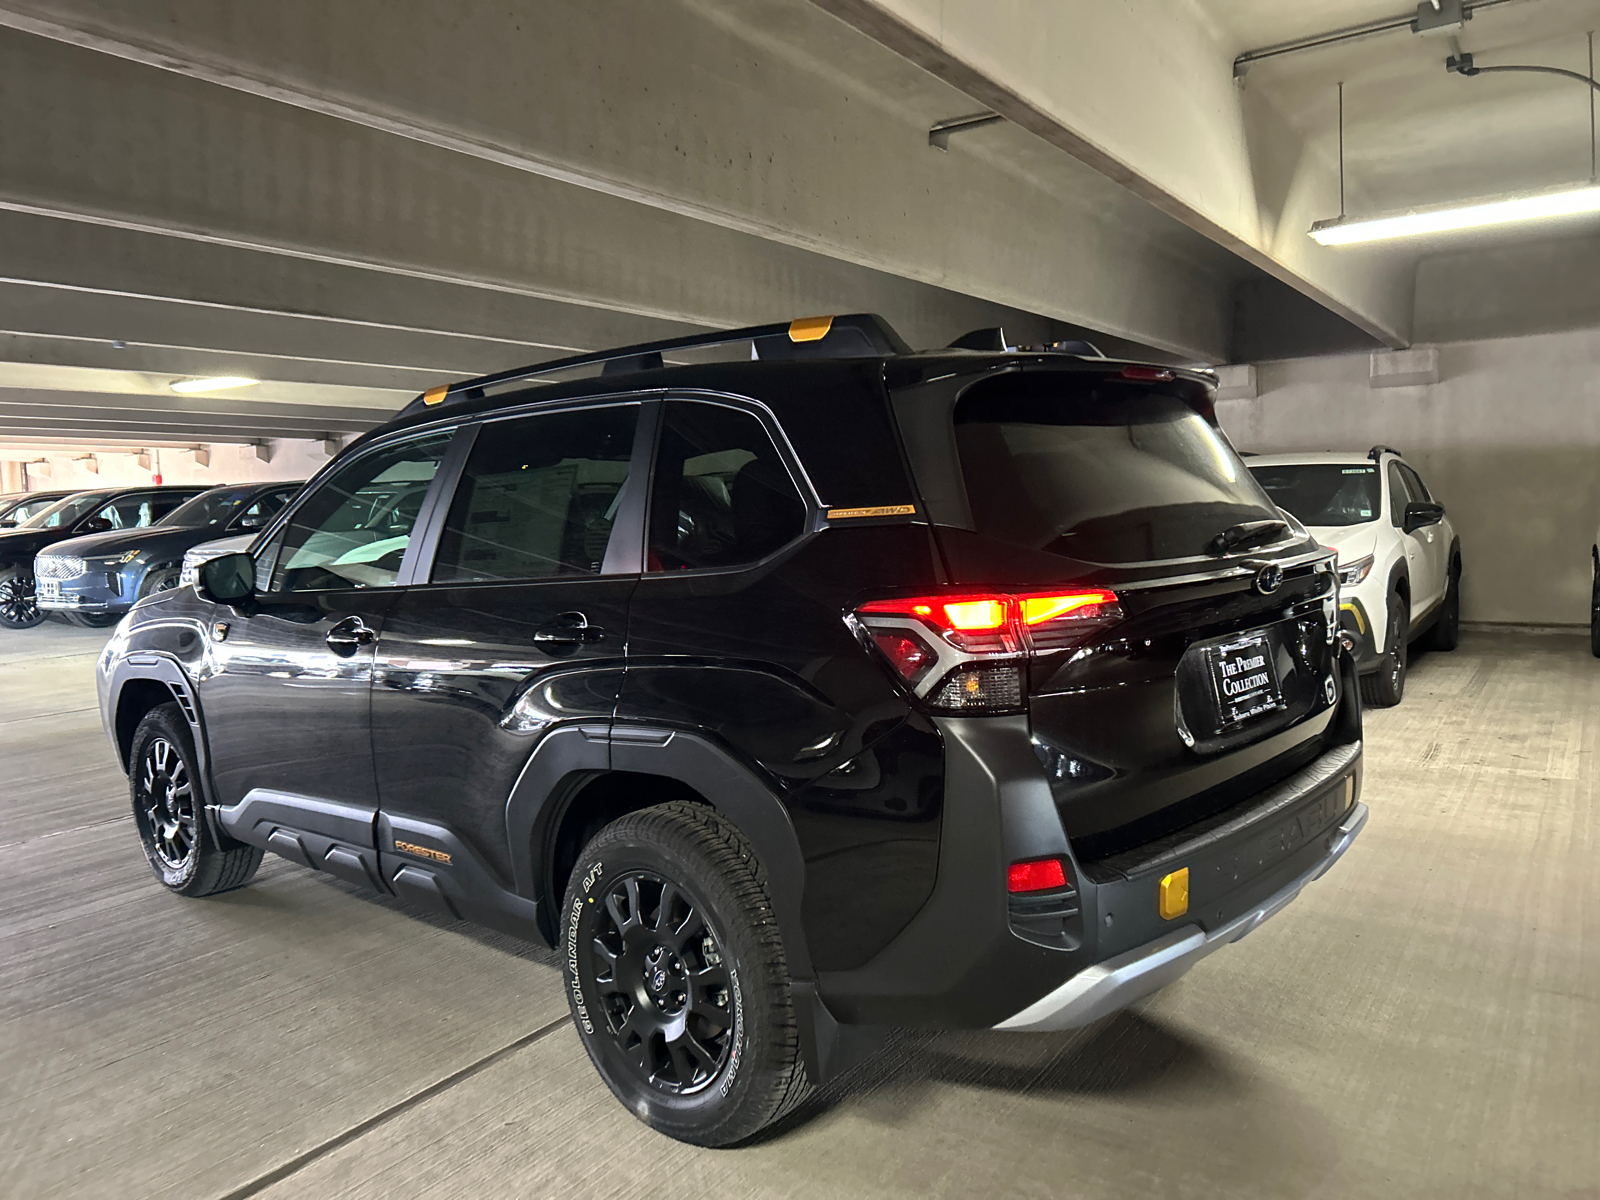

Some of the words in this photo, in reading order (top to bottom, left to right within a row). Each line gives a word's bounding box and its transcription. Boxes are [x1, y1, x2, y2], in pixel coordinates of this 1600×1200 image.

[1219, 661, 1237, 677] THE
[1223, 672, 1269, 695] COLLECTION
[394, 839, 453, 864] FORESTER
[567, 897, 595, 1035] GEOLANDAR
[582, 862, 603, 893] A/T
[720, 968, 745, 1098] YOKOHAMA
